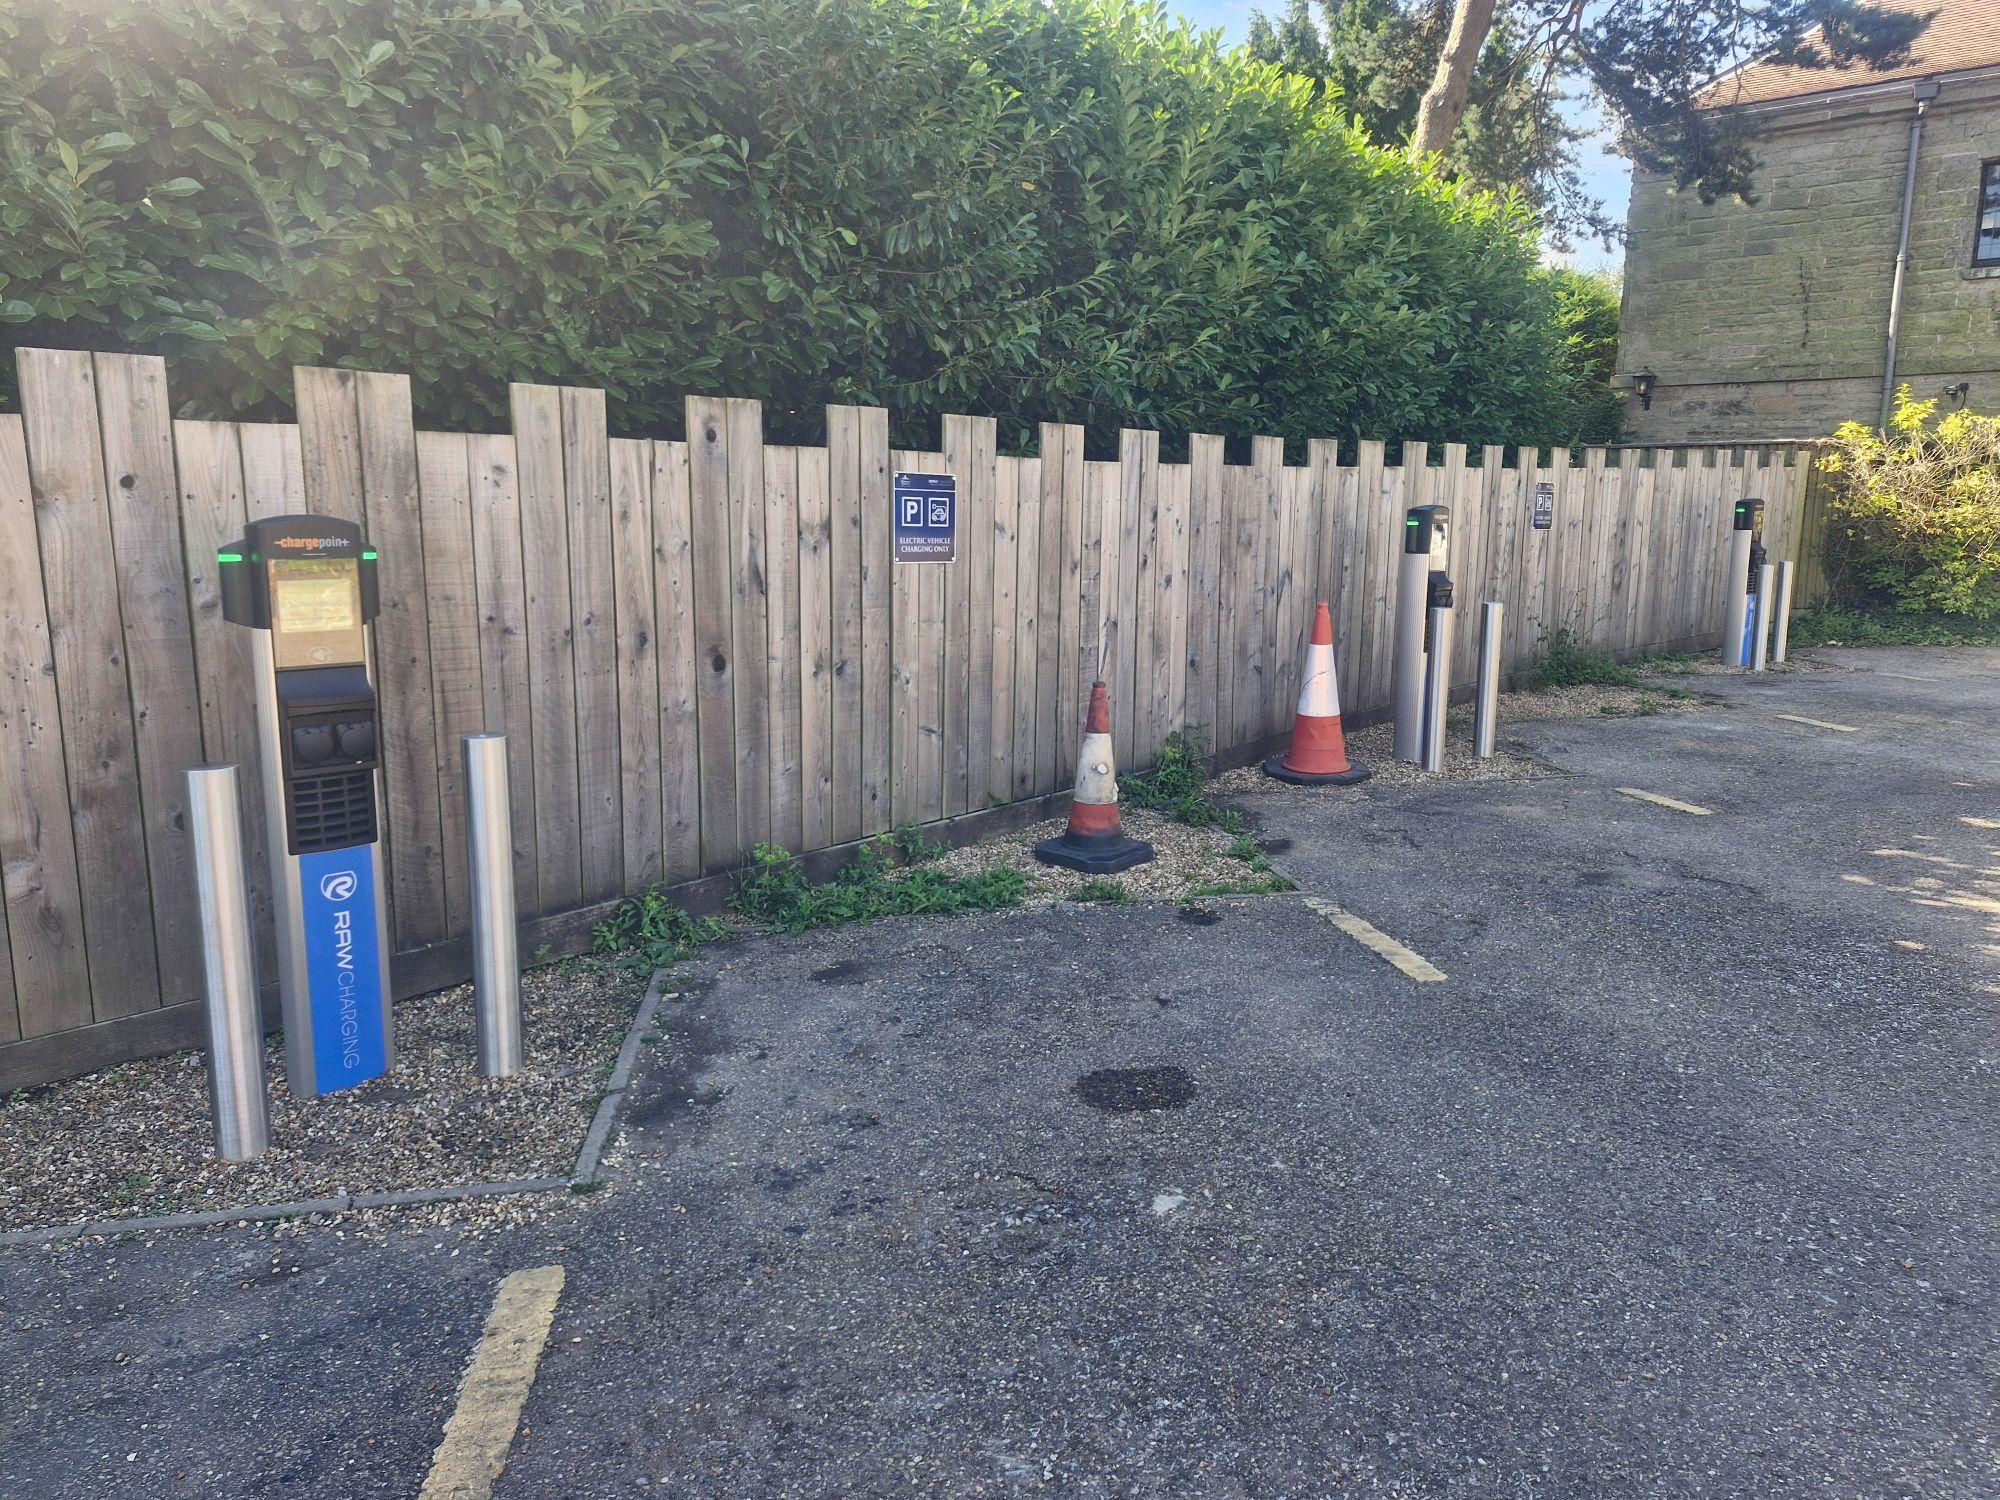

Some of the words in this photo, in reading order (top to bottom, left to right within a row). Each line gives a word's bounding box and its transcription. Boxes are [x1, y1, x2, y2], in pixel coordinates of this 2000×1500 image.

[906, 501, 918, 522] P
[899, 537, 927, 545] ELECTRIC
[927, 537, 951, 545] VEHICLE
[901, 545, 933, 553] CHARGING
[933, 545, 950, 553] ONLY
